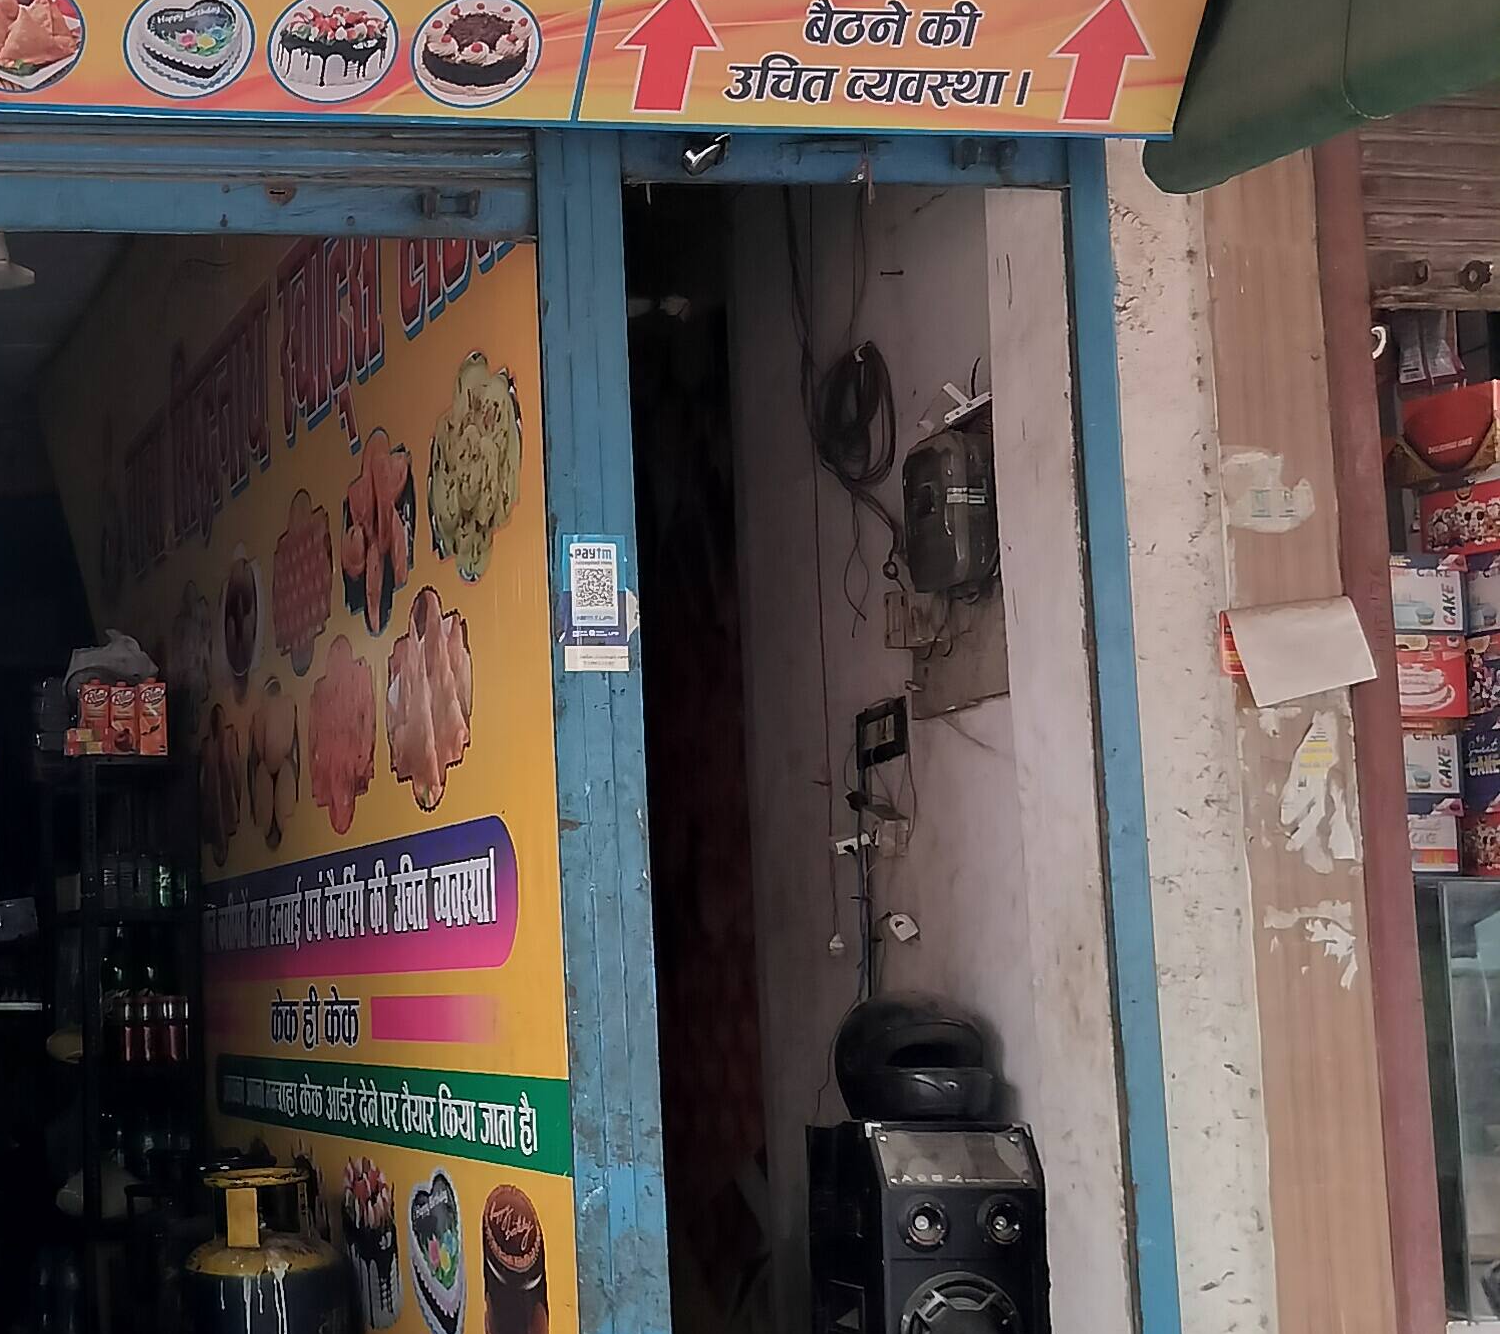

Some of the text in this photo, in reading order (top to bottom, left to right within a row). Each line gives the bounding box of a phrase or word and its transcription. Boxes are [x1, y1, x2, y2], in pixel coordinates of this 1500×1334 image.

[918, 0, 983, 49] की
[724, 53, 841, 105] उचित
[1440, 583, 1457, 627] CAKE
[1437, 745, 1453, 789] CAKE
[304, 869, 322, 943] एवं
[367, 858, 390, 936] की
[390, 853, 429, 934] उचित
[270, 983, 362, 1051] केक ही केक
[299, 1072, 324, 1118] केक
[357, 1078, 379, 1129] देने
[380, 1089, 401, 1133] पर
[400, 1080, 437, 1138] तैयार
[437, 1082, 477, 1143] किया
[477, 1100, 517, 1149] जाता
